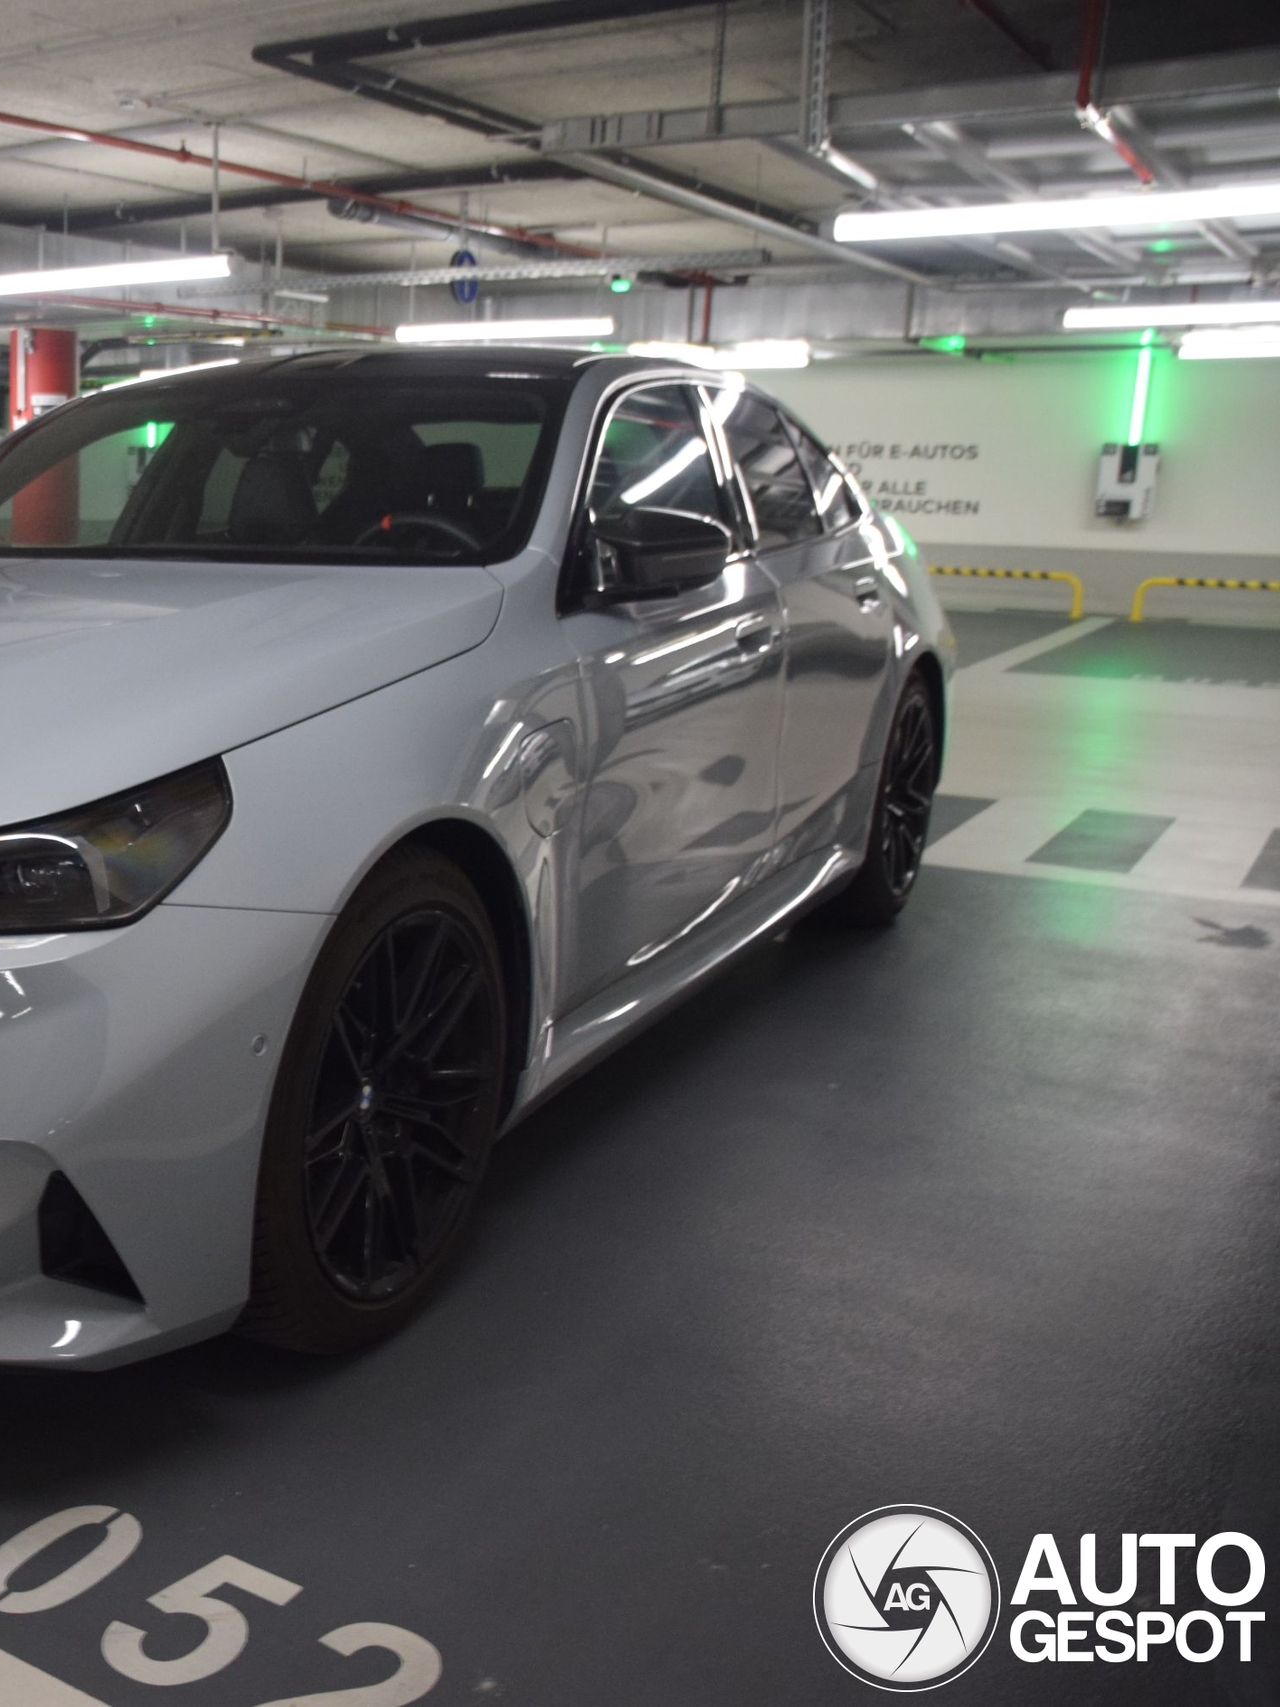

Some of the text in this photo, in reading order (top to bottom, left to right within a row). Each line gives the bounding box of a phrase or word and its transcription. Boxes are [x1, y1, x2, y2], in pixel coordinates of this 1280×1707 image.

[846, 441, 885, 460] FÜR
[889, 443, 980, 461] E-AUTOS
[878, 480, 928, 496] ALLE
[875, 498, 982, 515] RAUCHEN
